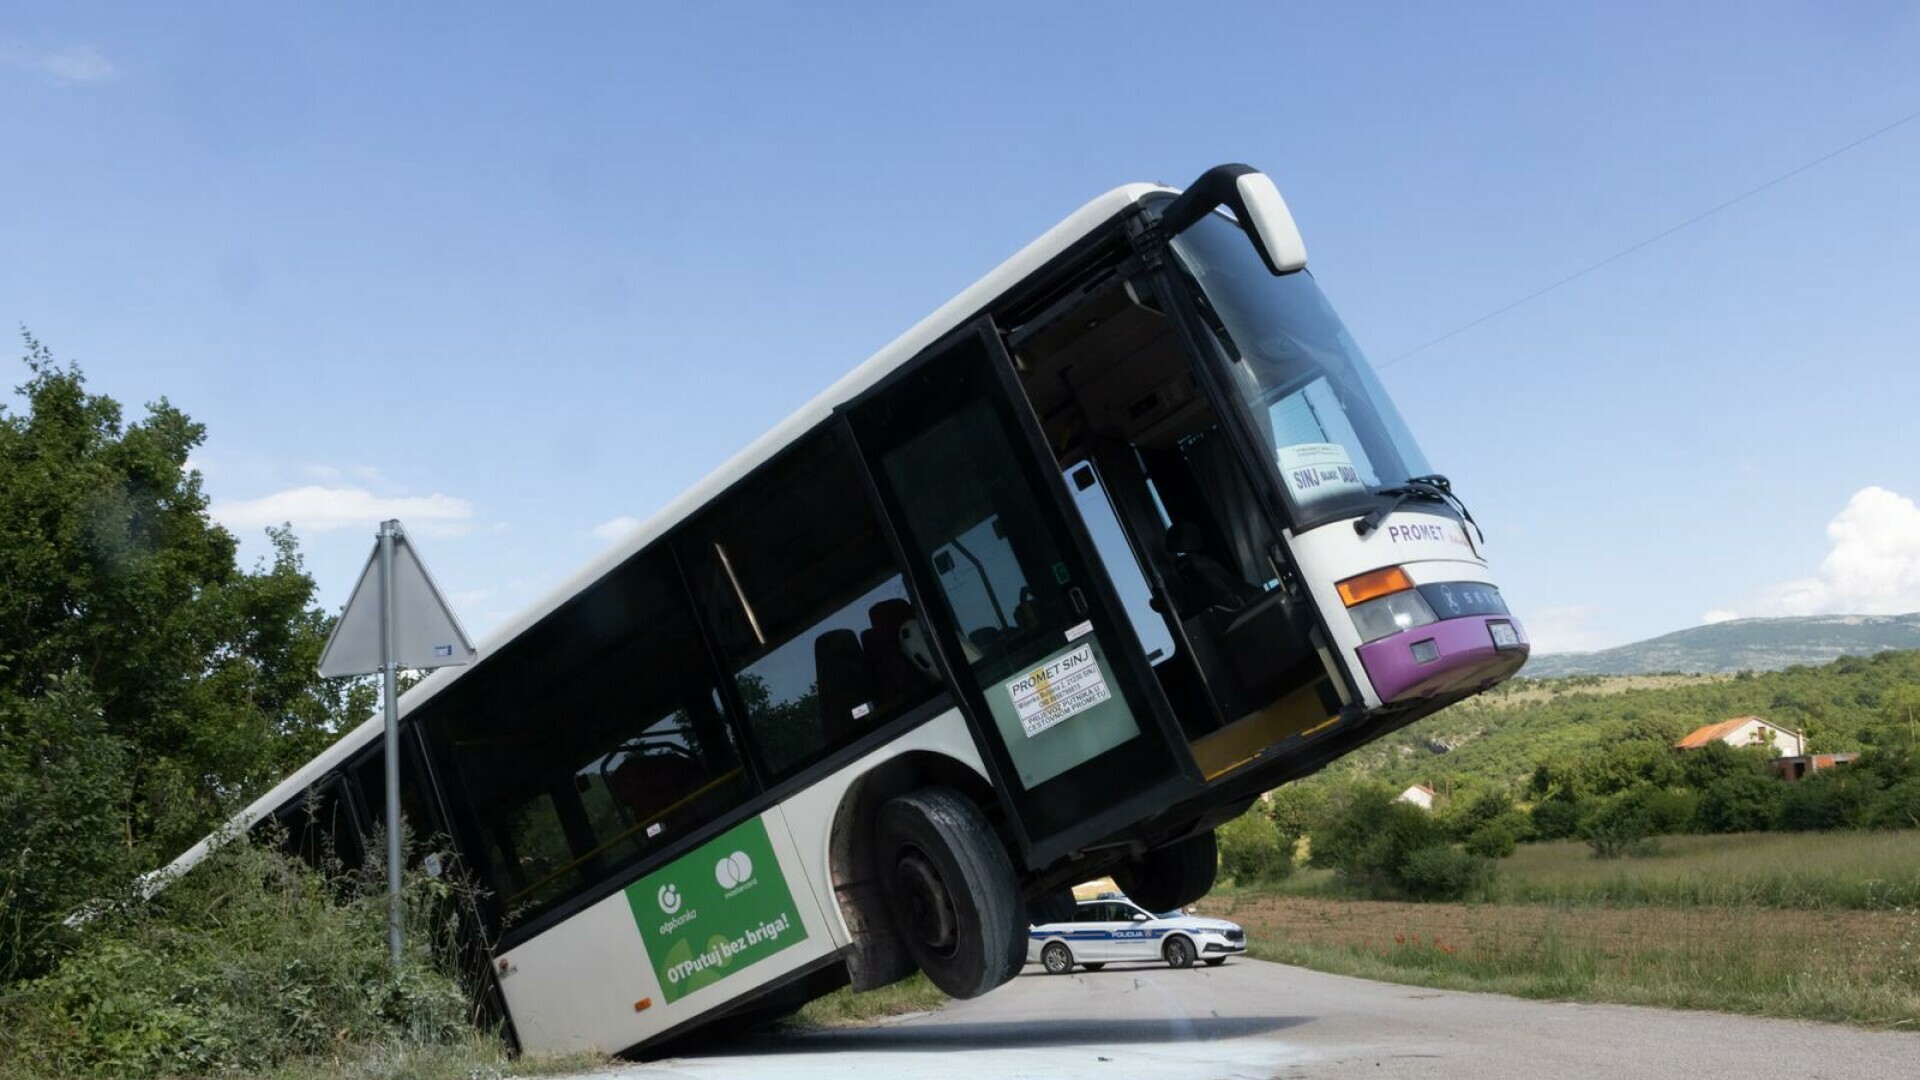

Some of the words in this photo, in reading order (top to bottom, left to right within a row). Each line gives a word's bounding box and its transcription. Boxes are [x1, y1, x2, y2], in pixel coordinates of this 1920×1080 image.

[1293, 467, 1320, 490] SINJ
[1388, 524, 1443, 543] PROMET
[1012, 664, 1061, 696] PROMET
[1061, 648, 1090, 670] SINJ
[1062, 688, 1093, 707] PUTNIKA
[667, 944, 722, 983] OTPutuj
[720, 937, 747, 957] bez
[745, 913, 790, 945] briga!
